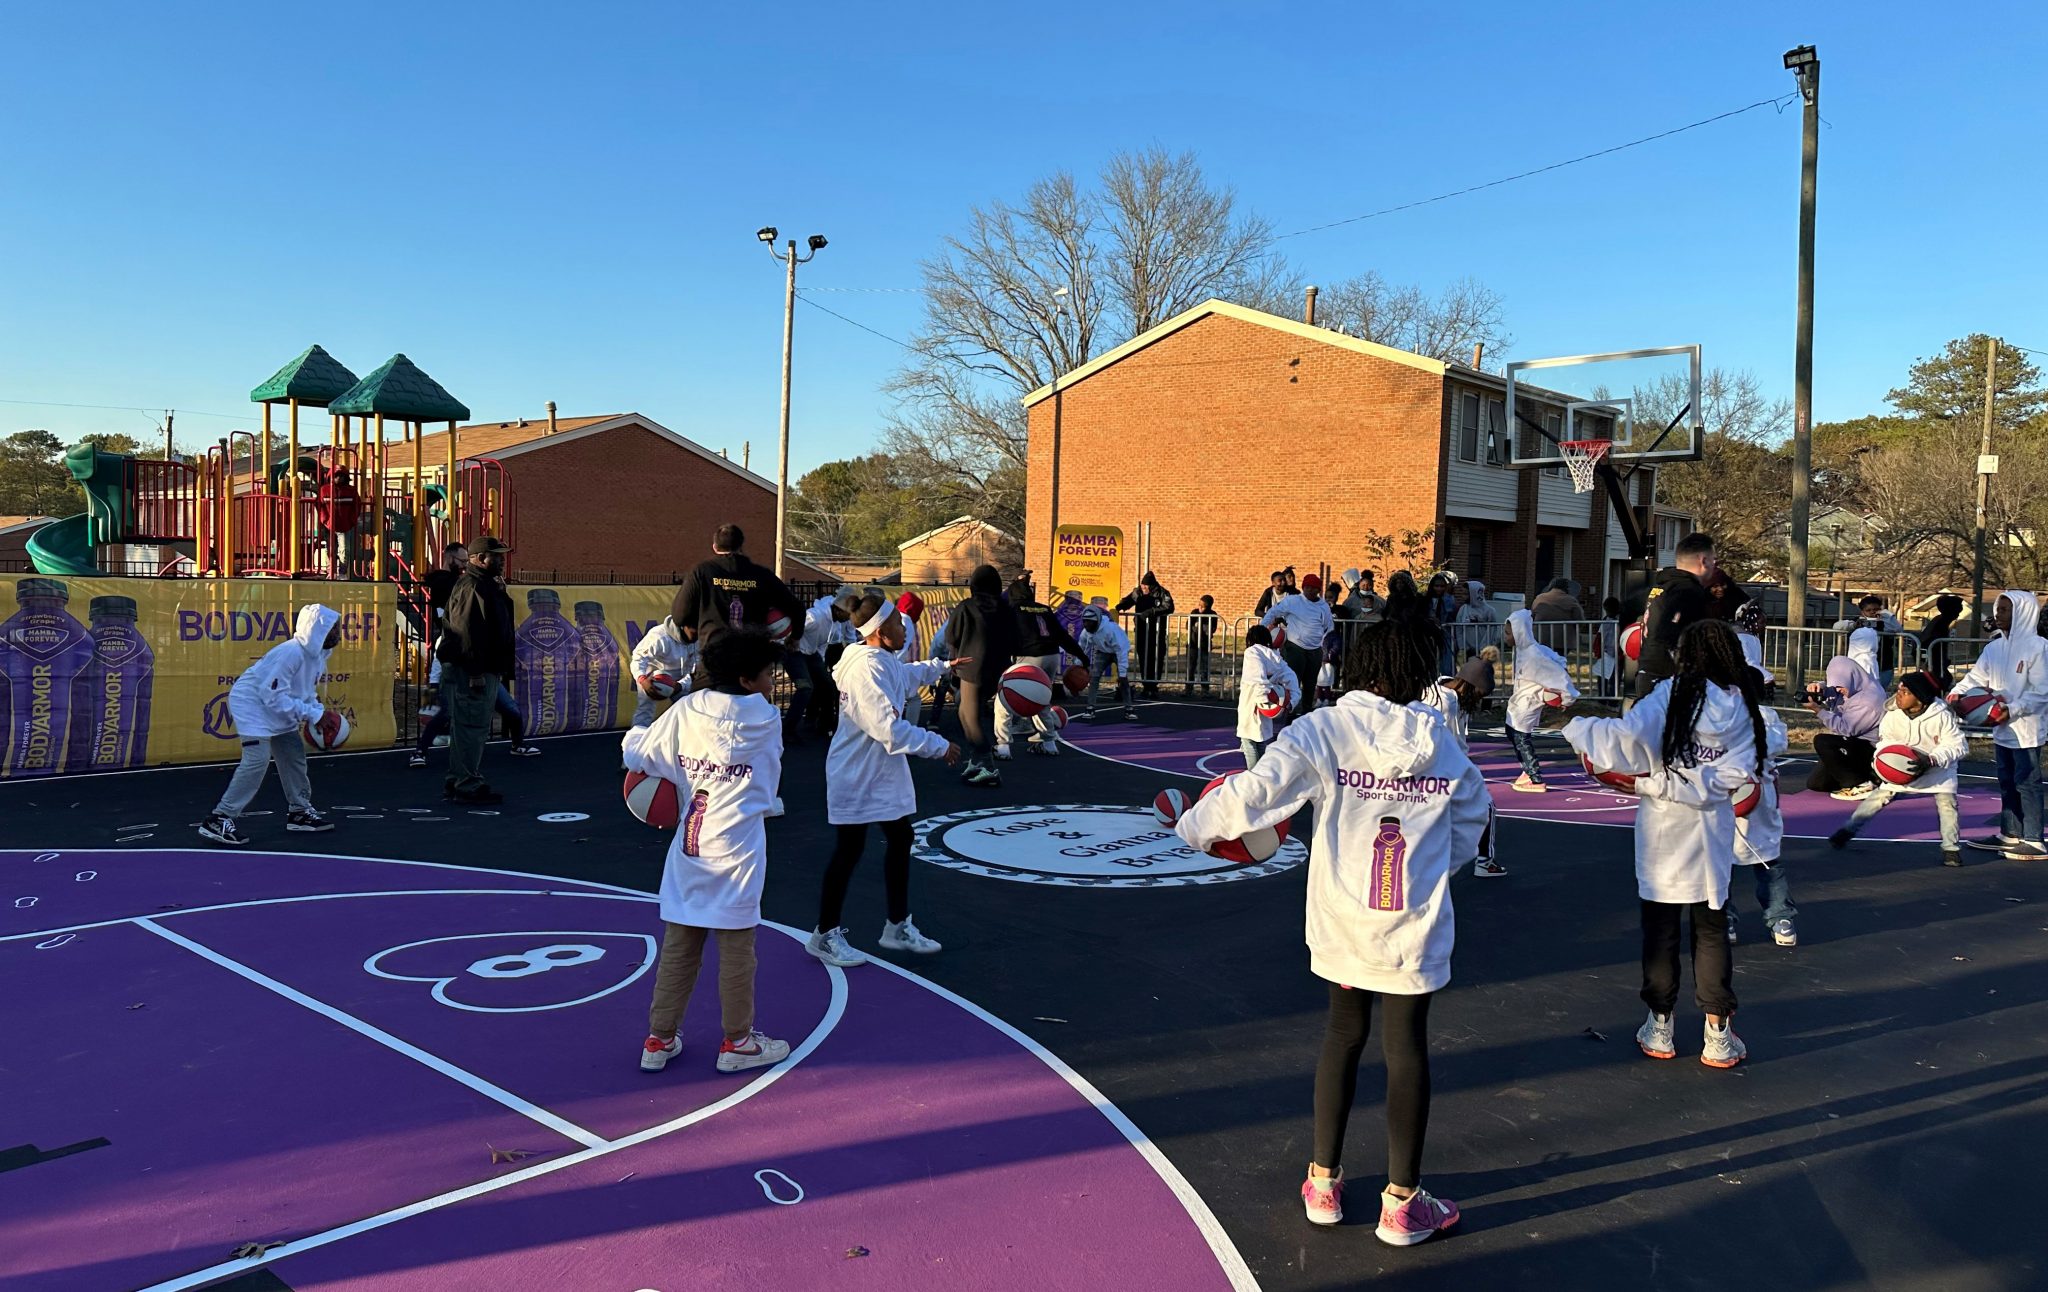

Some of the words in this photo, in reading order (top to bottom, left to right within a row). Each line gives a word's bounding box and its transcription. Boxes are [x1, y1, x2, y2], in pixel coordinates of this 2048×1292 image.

[1058, 545, 1117, 557] FOREVER
[1059, 533, 1117, 547] MAMBA
[1064, 559, 1110, 569] BODYARMOR
[712, 577, 757, 588] BODYARMOR
[178, 609, 382, 642] BODYAOR
[24, 635, 61, 643] FOREVER
[335, 673, 351, 683] OF
[538, 655, 556, 735] BODYARMOR
[24, 664, 52, 768] BODYARMOR
[97, 671, 122, 764] BODYARMOR
[22, 721, 31, 748] FOREVER
[677, 754, 753, 779] BODYARMOR
[688, 772, 711, 780] Sprts
[1336, 768, 1451, 796] BODYARMOR
[1356, 788, 1395, 802] Sports
[1396, 791, 1428, 804] Drink
[972, 817, 1067, 836] Kobe
[1048, 830, 1095, 840] &
[1058, 830, 1176, 858] Gianna
[1110, 845, 1201, 868] Brya
[1380, 847, 1395, 908] BODYARMOR
[465, 943, 607, 978] 8
